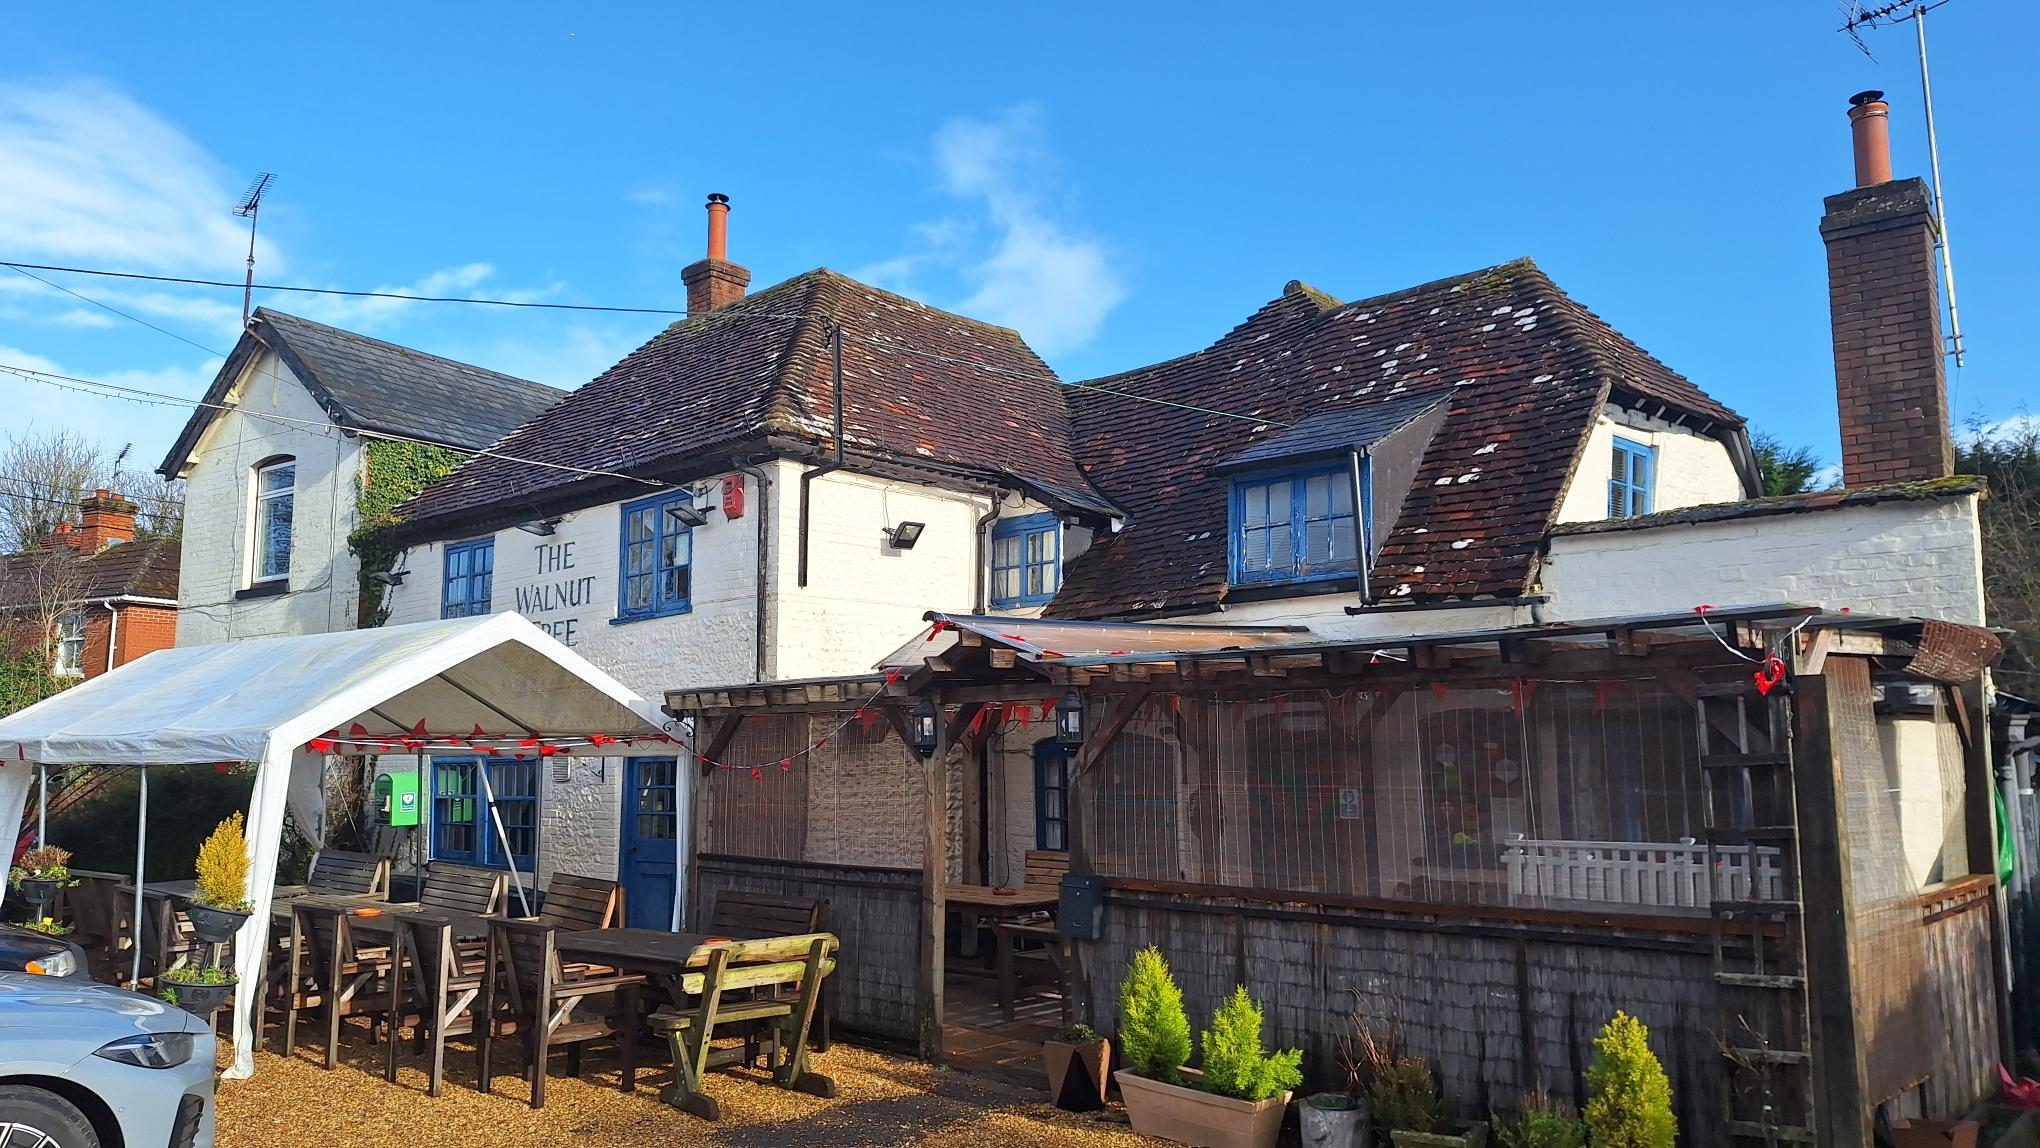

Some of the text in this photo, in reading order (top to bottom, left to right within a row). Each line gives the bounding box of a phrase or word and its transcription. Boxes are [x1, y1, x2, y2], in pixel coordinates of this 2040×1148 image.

[534, 542, 576, 575] THE
[515, 576, 596, 614] WALNUT
[532, 618, 579, 647] EE
